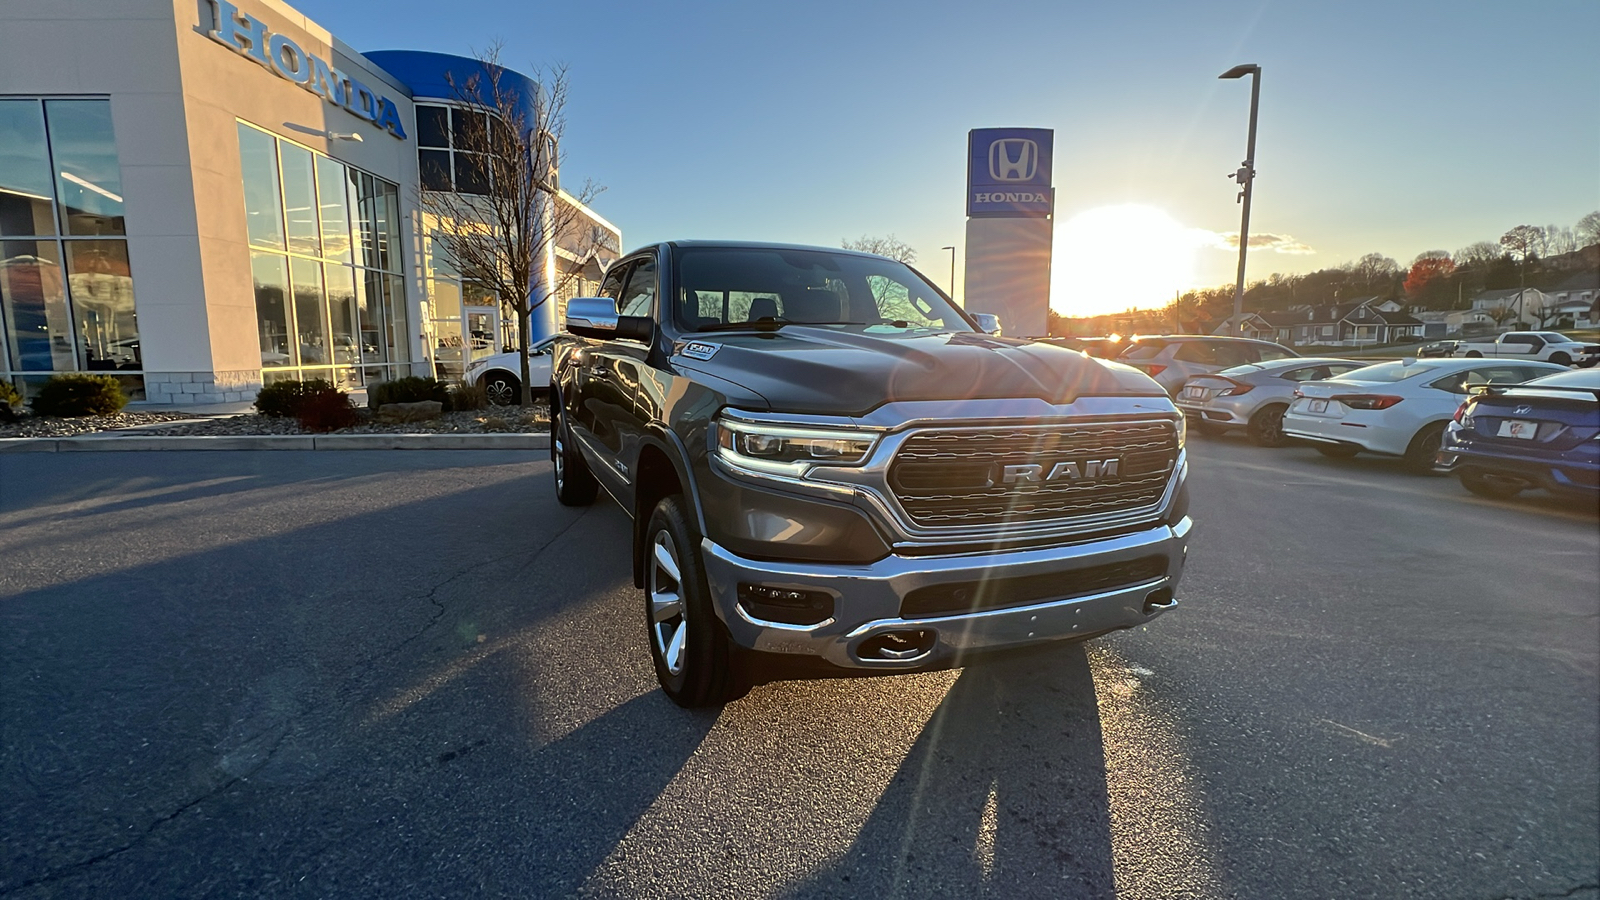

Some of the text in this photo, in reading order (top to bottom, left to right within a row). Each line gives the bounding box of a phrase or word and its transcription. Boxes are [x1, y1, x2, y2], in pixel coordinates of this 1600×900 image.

[208, 0, 407, 140] HONDA
[975, 192, 1048, 203] HONDA
[1003, 458, 1119, 483] RAM
